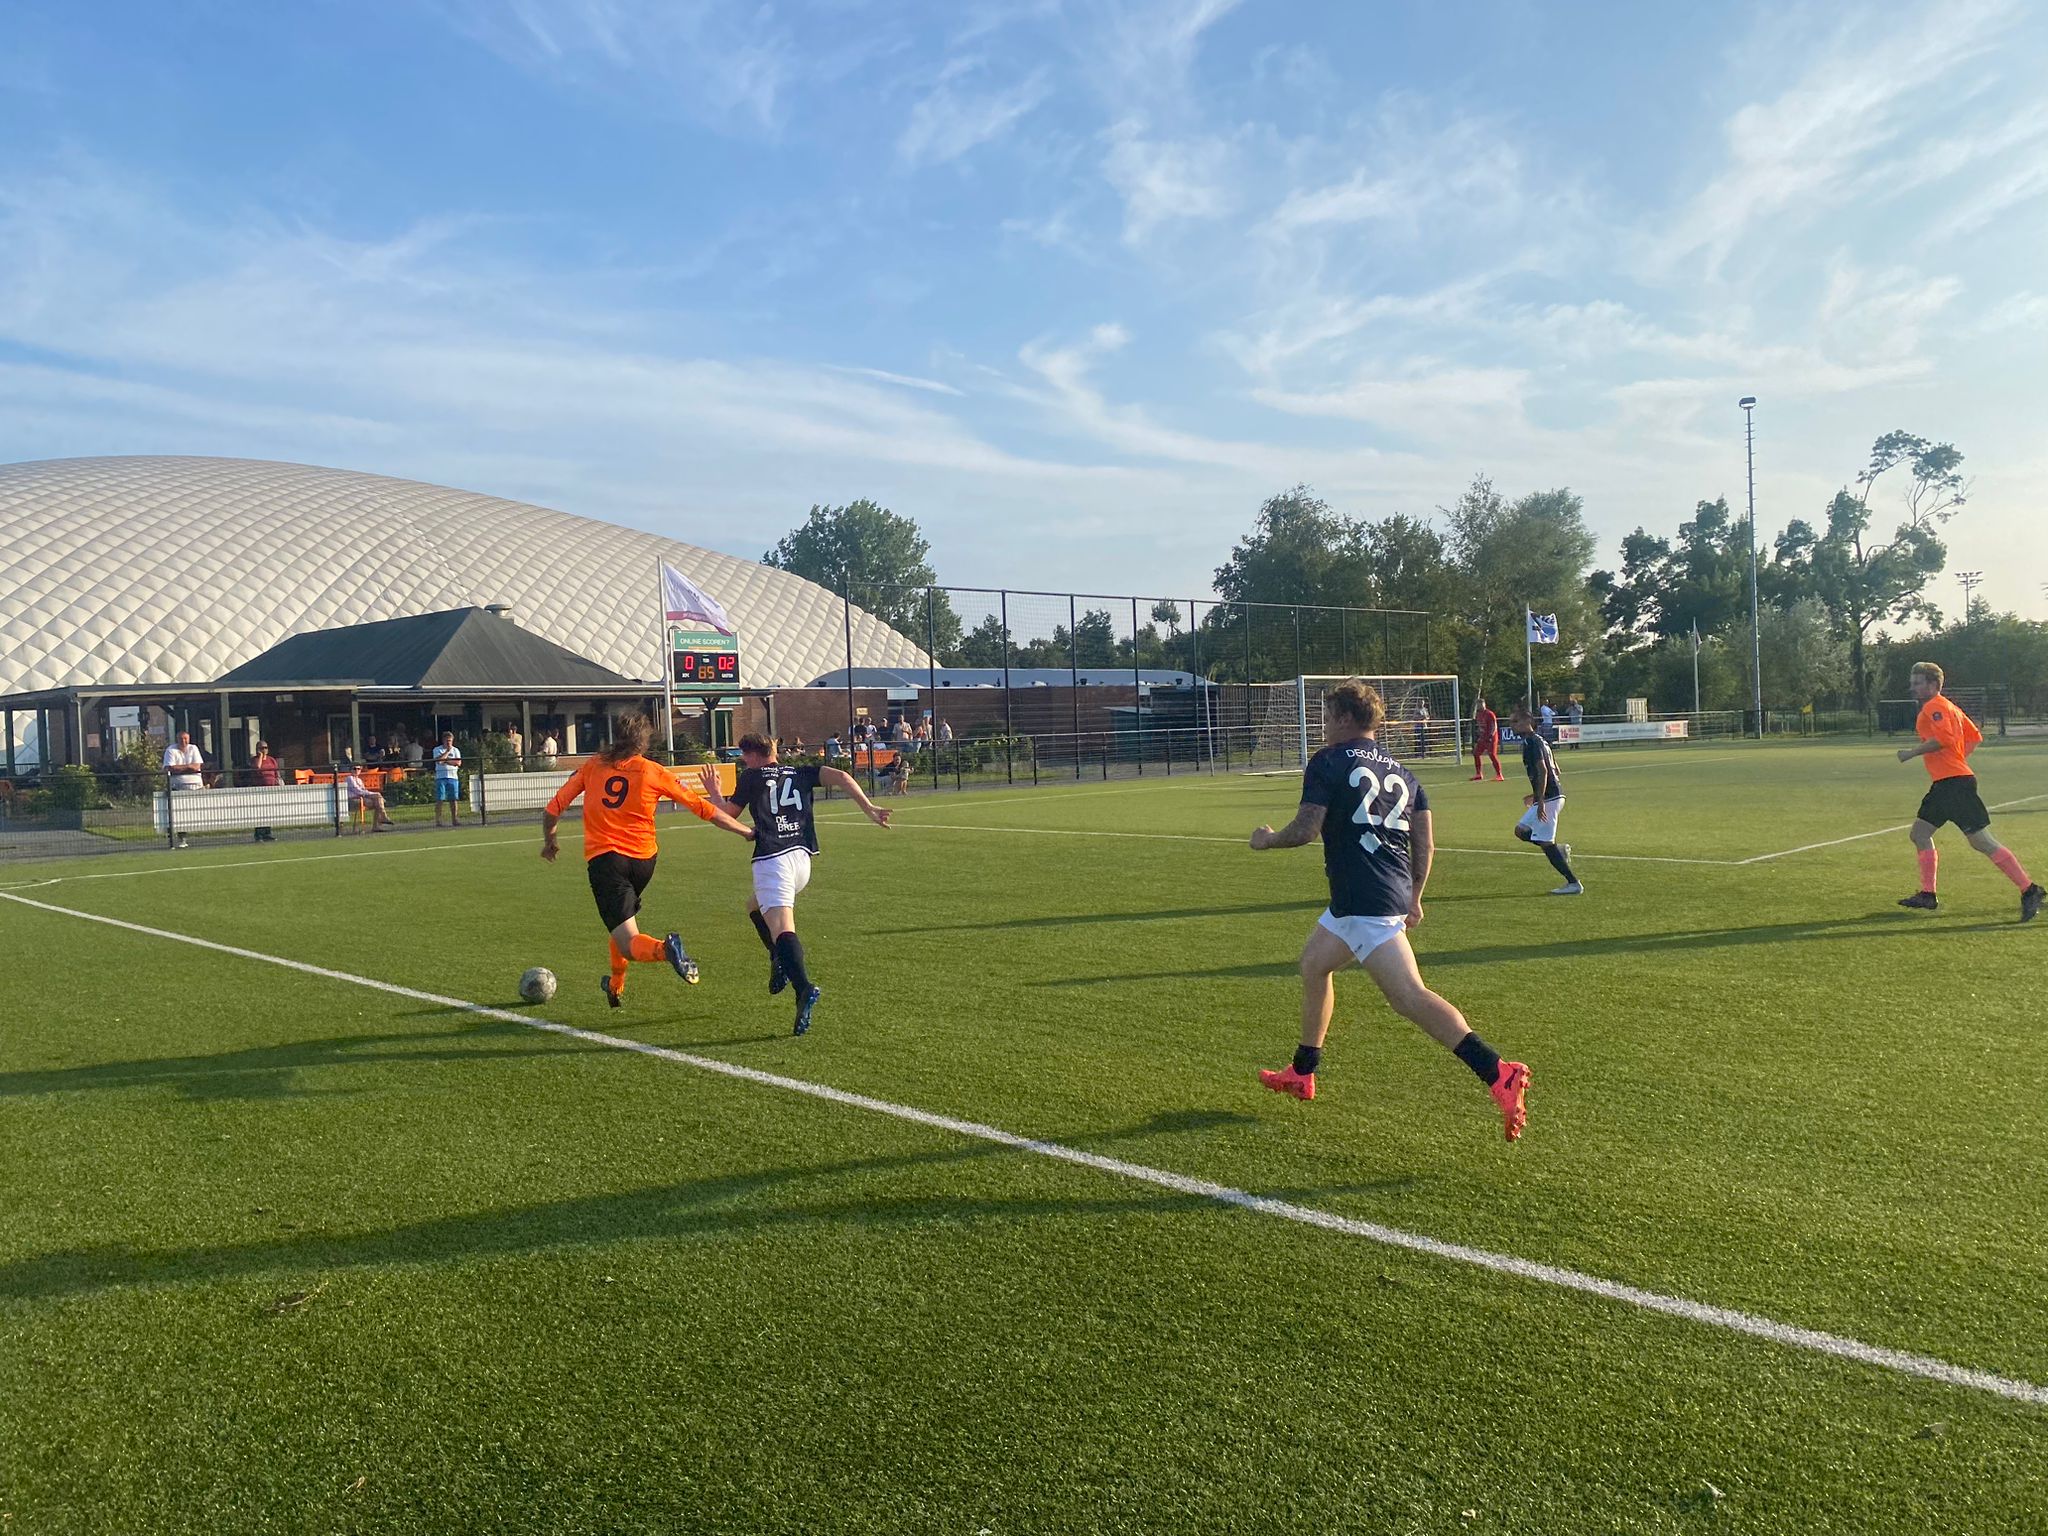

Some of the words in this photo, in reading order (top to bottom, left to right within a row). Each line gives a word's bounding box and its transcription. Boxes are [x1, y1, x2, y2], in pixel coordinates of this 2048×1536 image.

[685, 655, 694, 670] 0
[718, 656, 735, 670] 02
[601, 775, 629, 809] 9
[765, 777, 803, 814] 14
[1348, 766, 1410, 831] 22
[775, 815, 789, 824] DE
